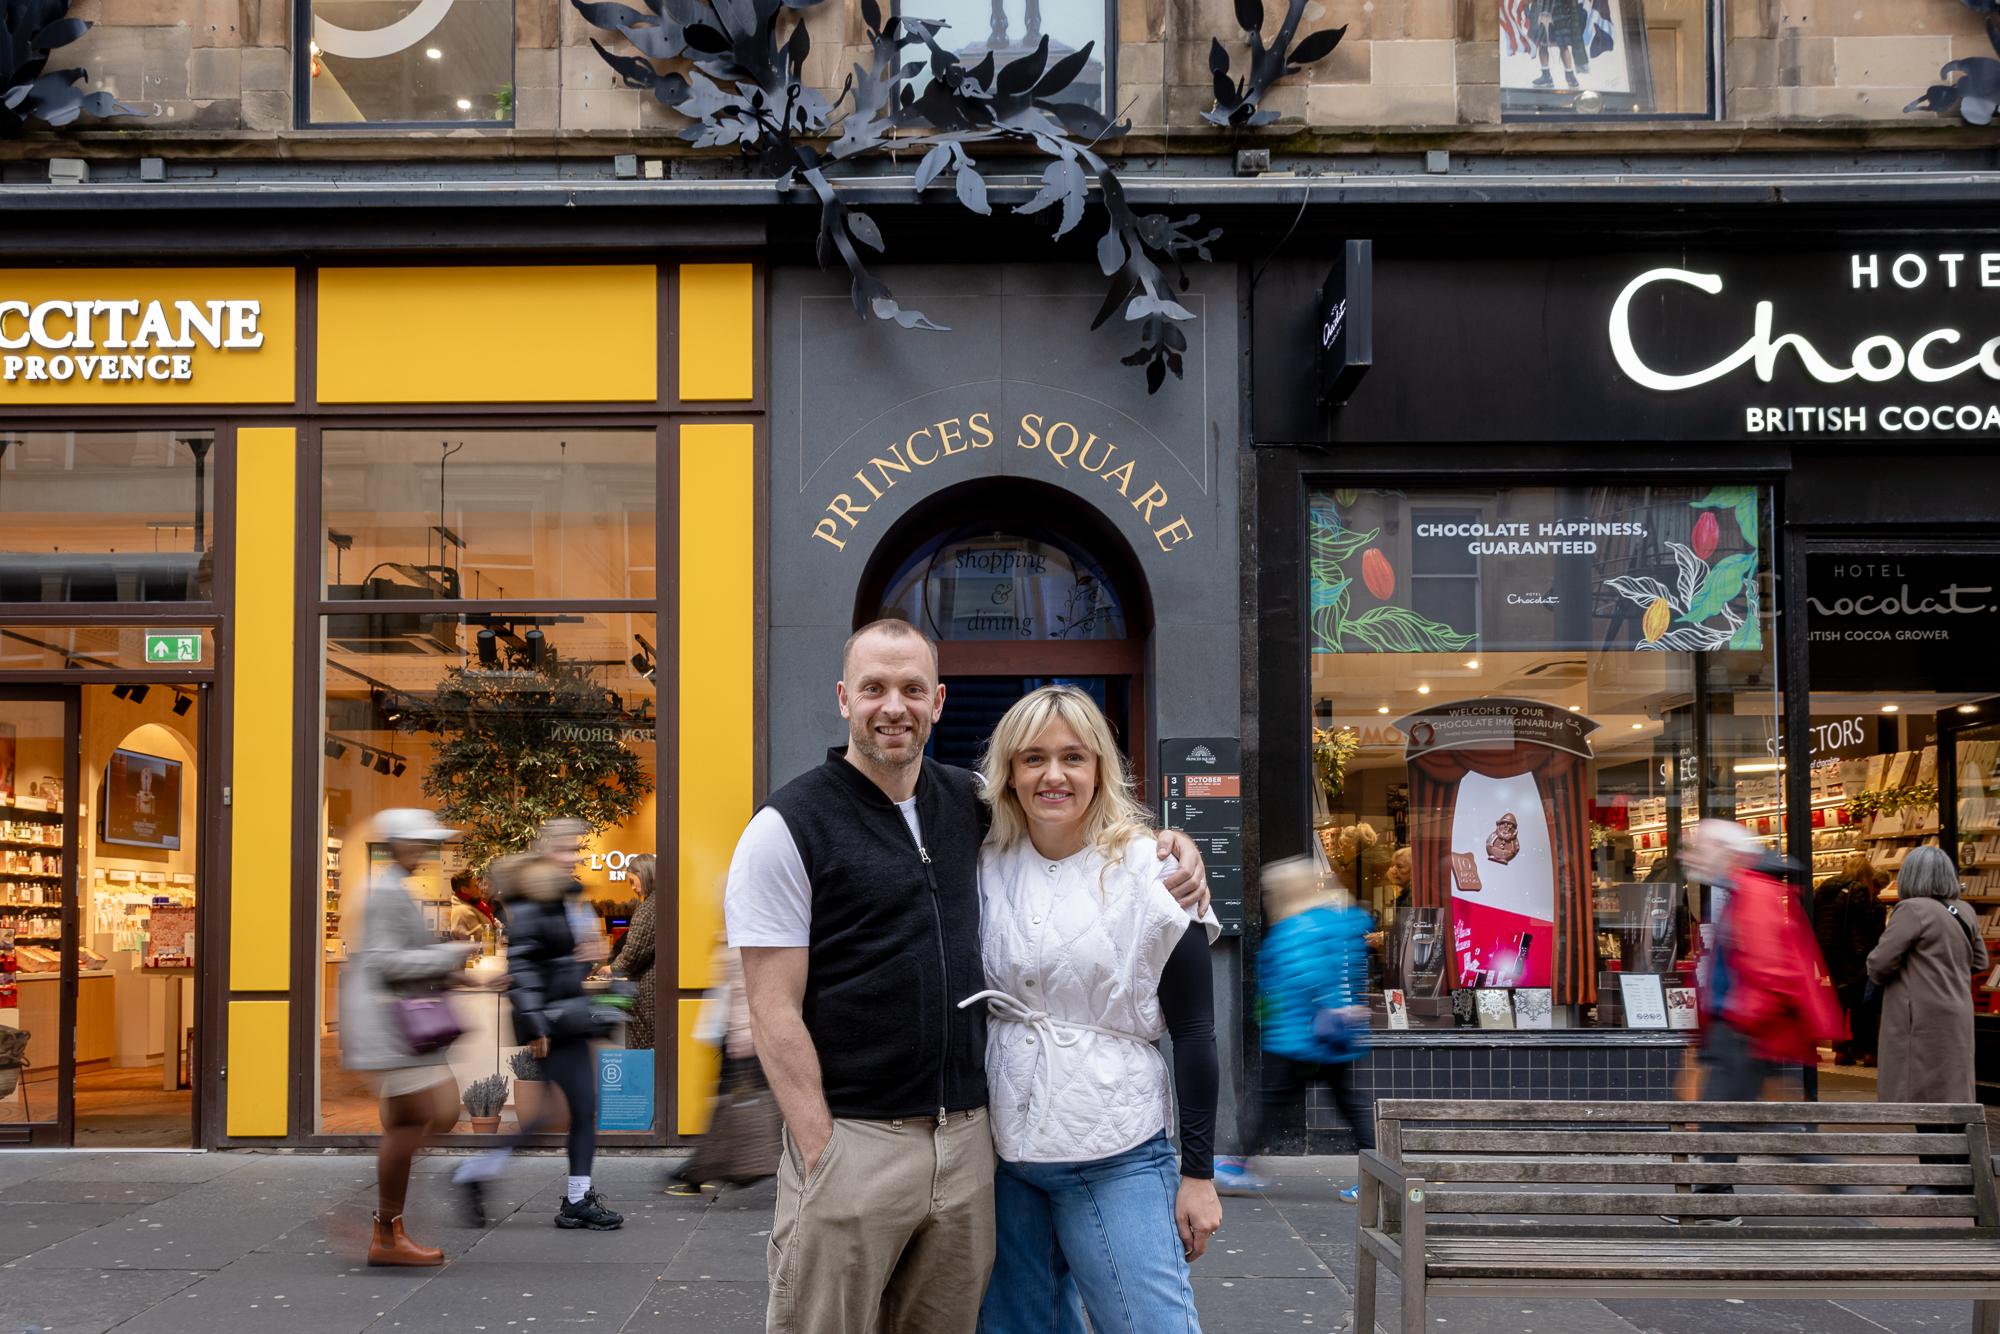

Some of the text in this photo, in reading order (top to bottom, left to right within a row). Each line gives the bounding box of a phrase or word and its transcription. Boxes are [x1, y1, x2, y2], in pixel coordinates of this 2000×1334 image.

[1851, 253, 2000, 289] HOTE
[3, 355, 192, 380] PROVENCE
[1746, 405, 2000, 431] BRITISH COCOA
[811, 412, 1196, 553] PRINCES SQUARE
[1416, 522, 1648, 539] CHOCOLATE HAPPINESS,
[1467, 541, 1597, 555] GUARANTEED
[955, 547, 1048, 575] shopping
[1834, 564, 1906, 577] HOTEL
[991, 583, 1014, 605] &
[967, 608, 1034, 637] dining
[1844, 630, 1892, 641] COCOA
[1895, 630, 1950, 641] GROWER
[1449, 706, 1544, 718] WELCOME TO OUR
[1432, 718, 1564, 731] CHOCOLATE IMAGINARIUM
[609, 871, 626, 881] EN
